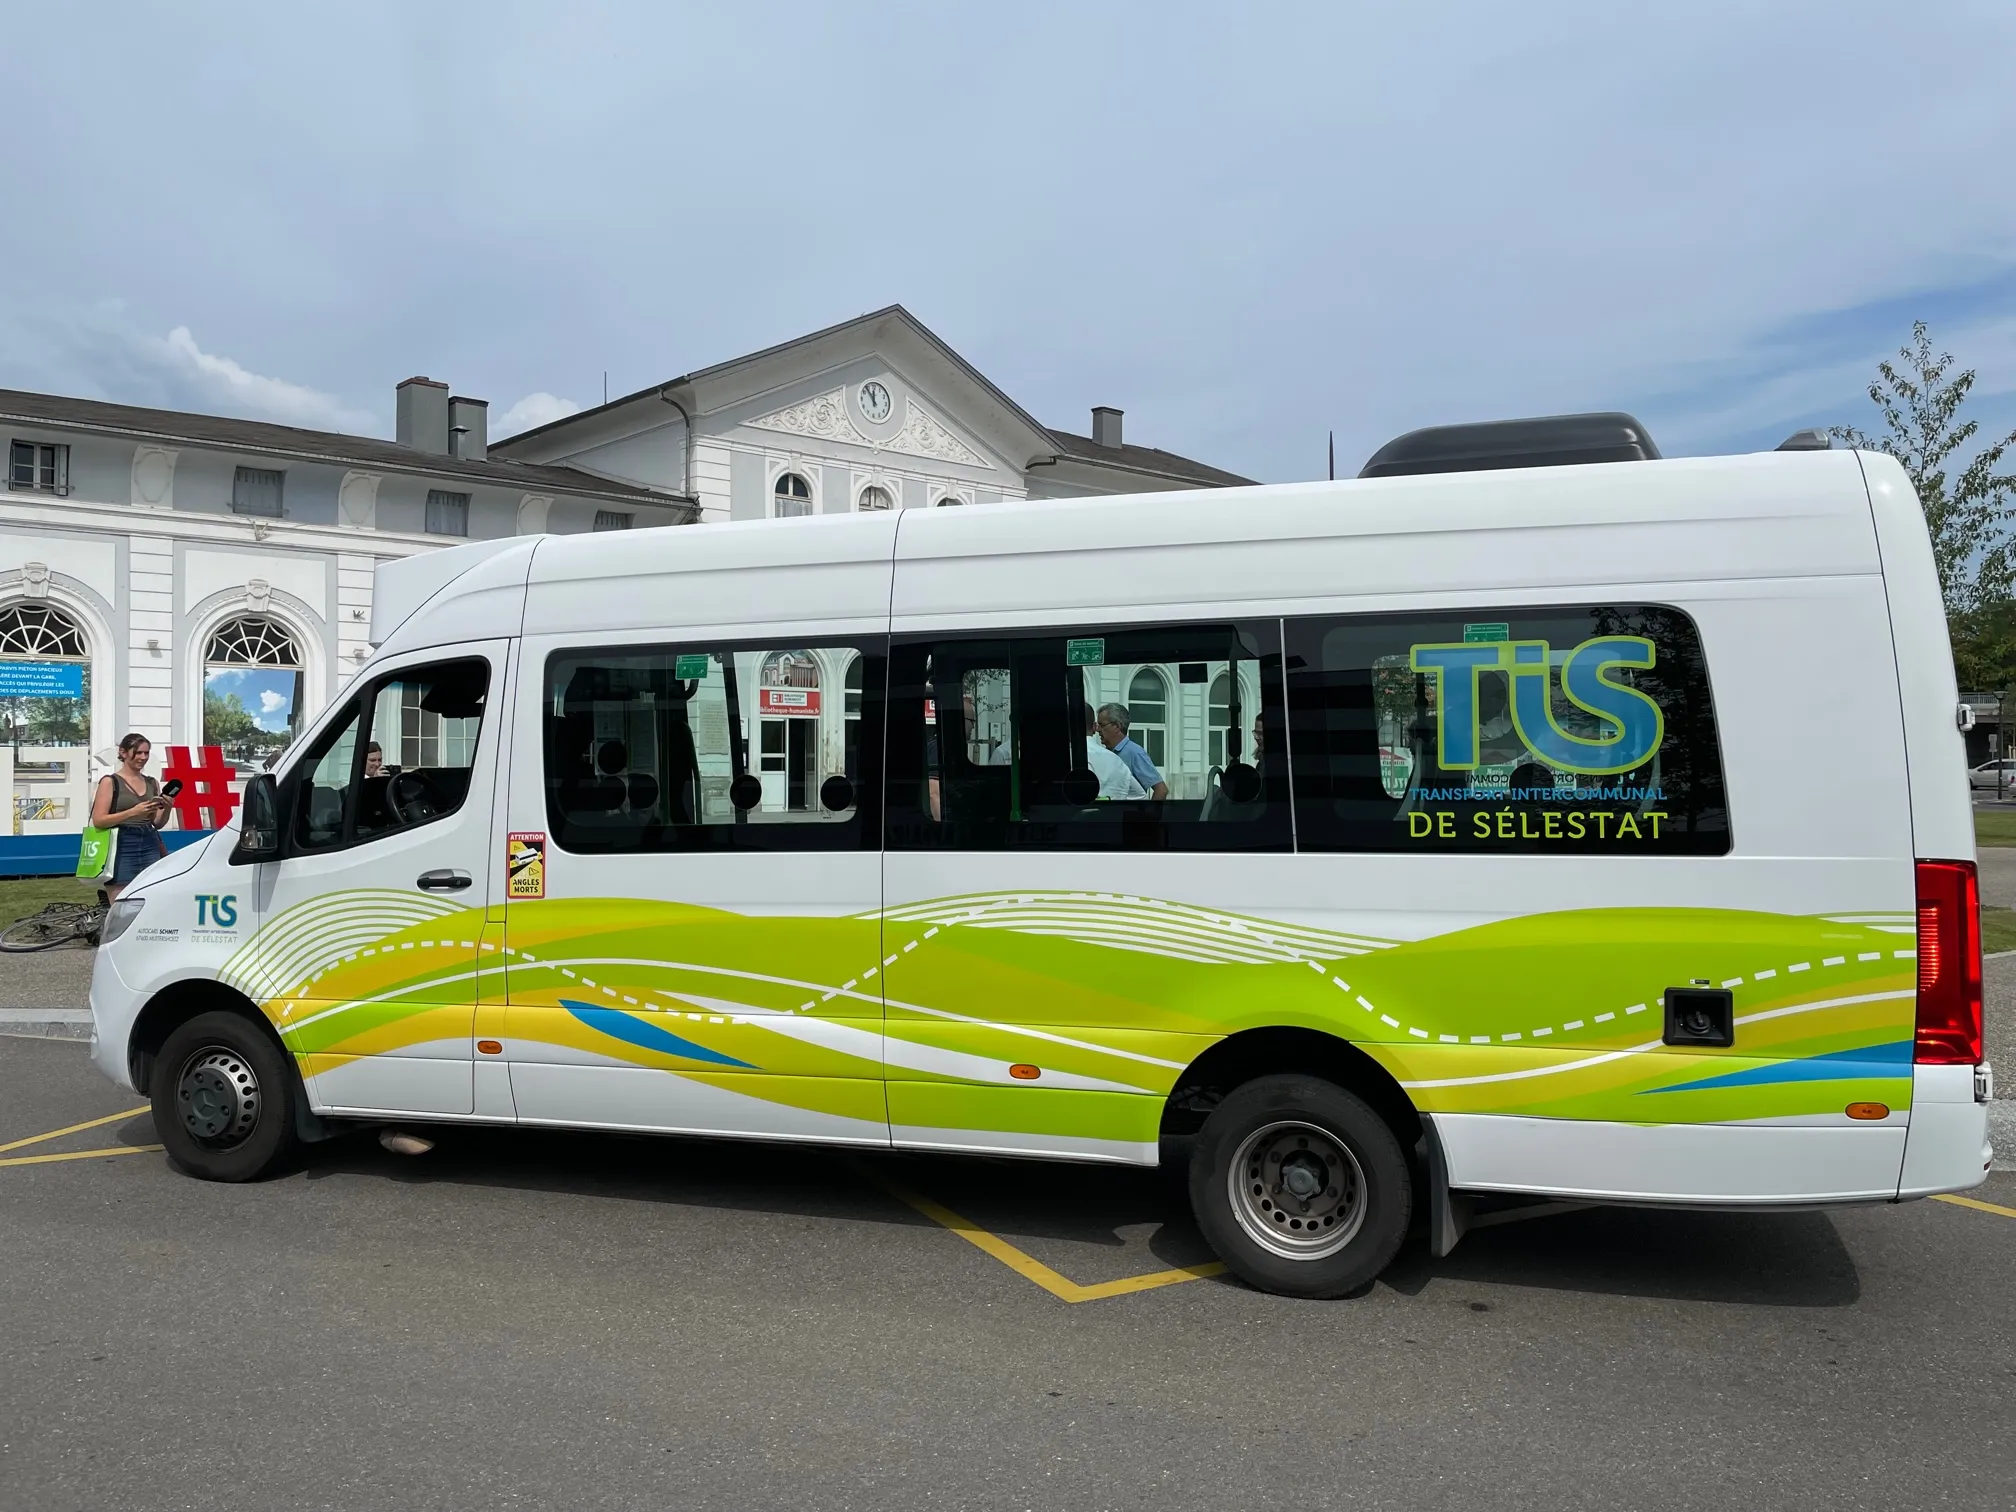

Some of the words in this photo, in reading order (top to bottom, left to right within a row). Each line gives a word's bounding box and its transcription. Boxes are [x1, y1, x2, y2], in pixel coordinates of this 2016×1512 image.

[1409, 788, 1504, 801] TRANSPORT
[1512, 787, 1668, 801] INTERCOMMUNAL
[1408, 811, 1457, 838] DE
[1473, 806, 1669, 839] SÉLESTAT
[191, 935, 201, 943] DE
